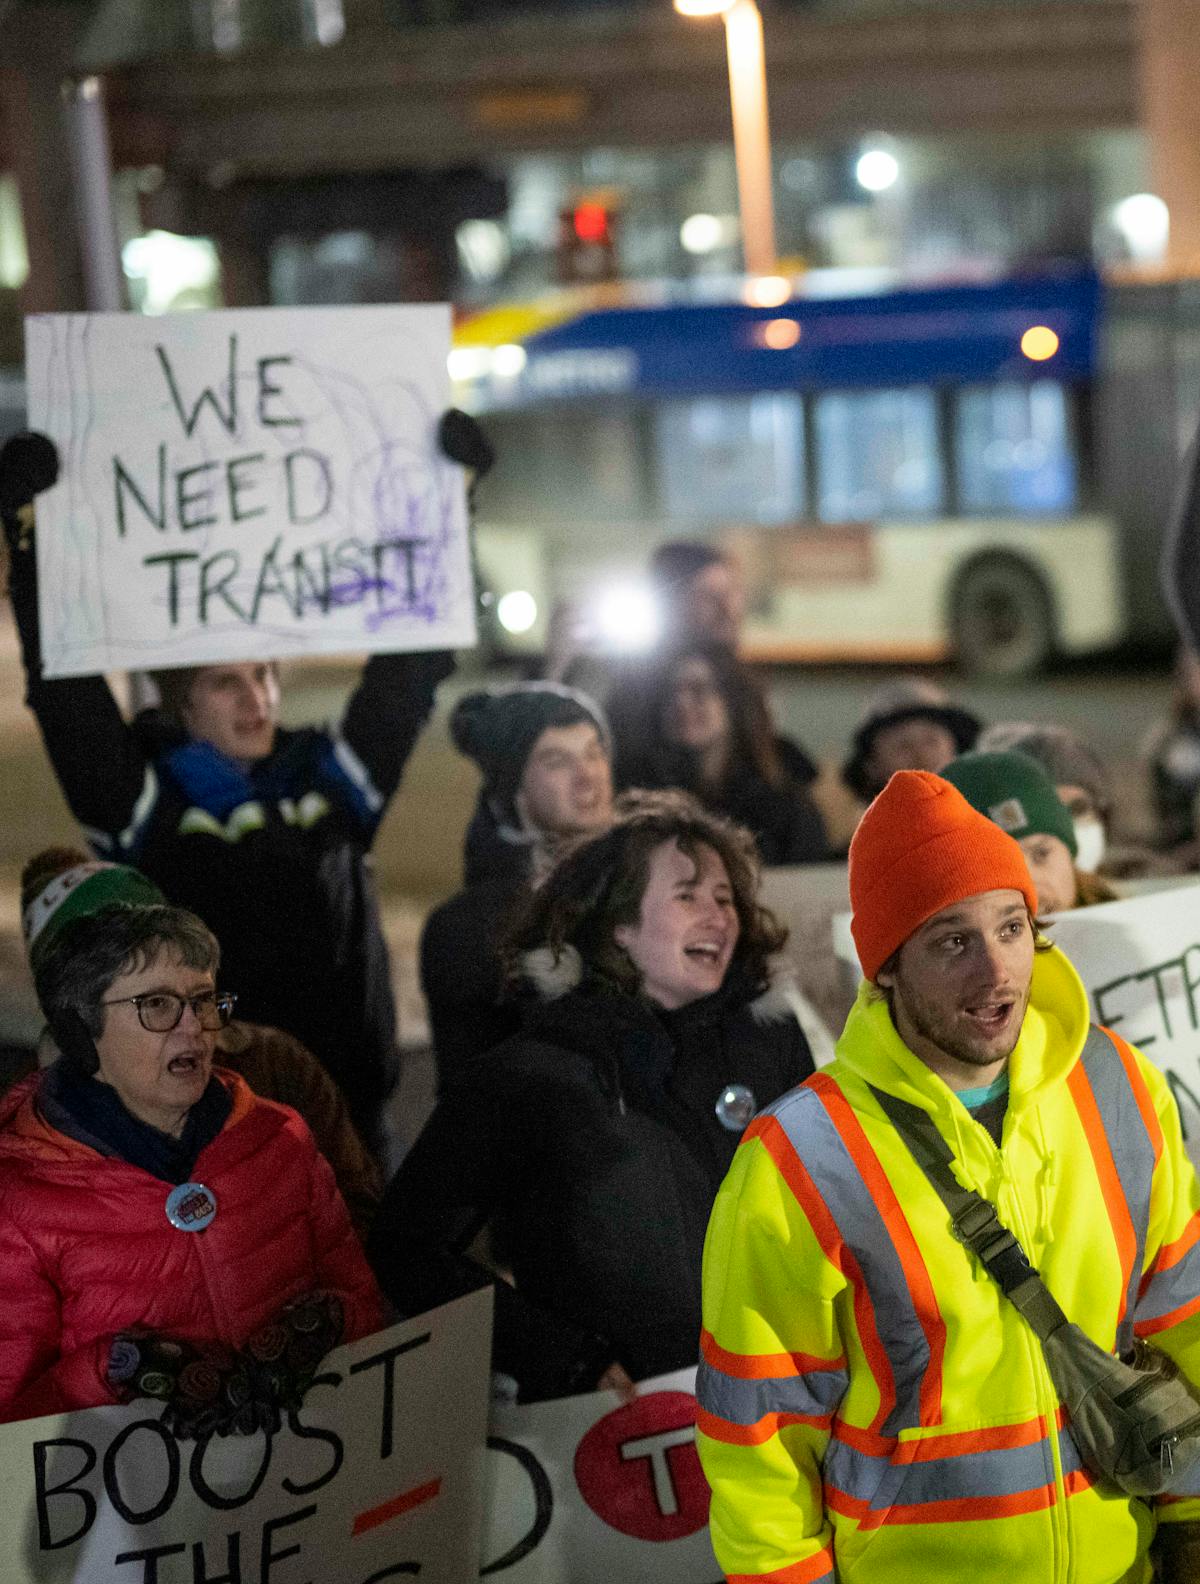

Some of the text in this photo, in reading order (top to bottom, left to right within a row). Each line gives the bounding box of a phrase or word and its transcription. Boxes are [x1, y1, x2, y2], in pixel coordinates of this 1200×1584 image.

[155, 331, 305, 439] WE
[111, 443, 335, 538] NEED
[143, 534, 428, 628] TRANSIT
[33, 1333, 432, 1551] BOOST
